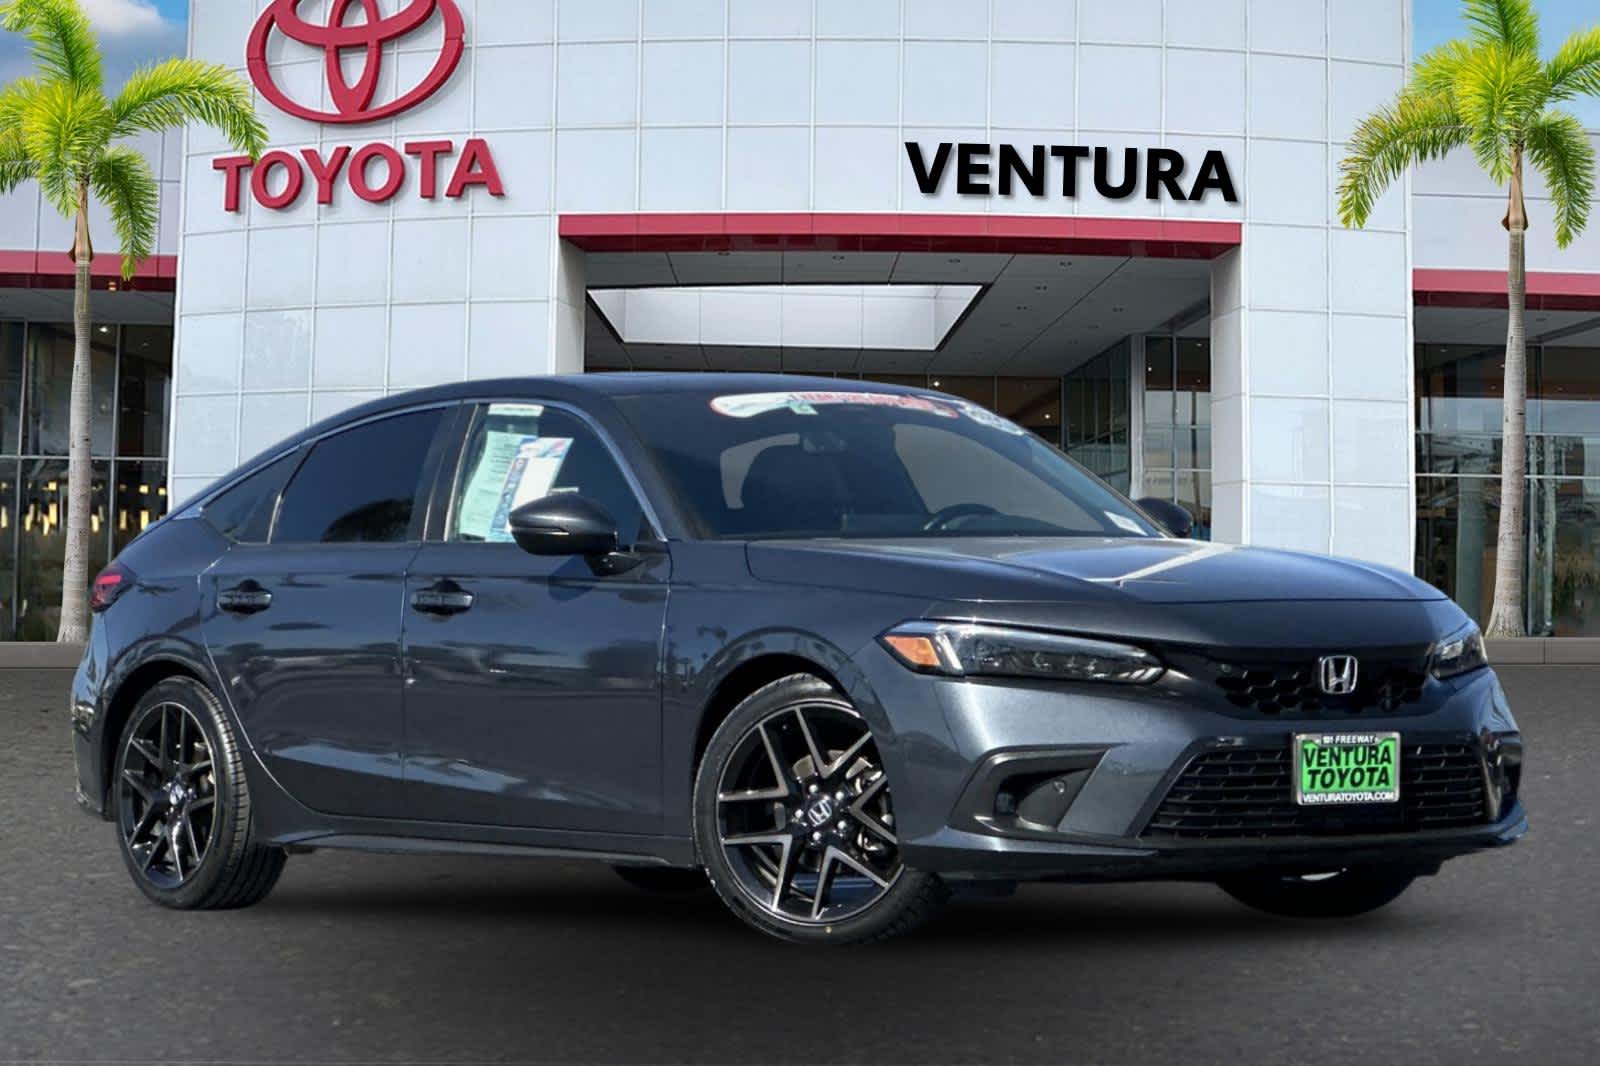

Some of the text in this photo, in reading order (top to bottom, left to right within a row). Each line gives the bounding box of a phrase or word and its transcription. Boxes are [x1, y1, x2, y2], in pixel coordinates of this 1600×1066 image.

[212, 138, 505, 212] TOYOTA
[905, 142, 1240, 203] VENTURA
[1335, 735, 1375, 745] FREEWAY
[1303, 745, 1393, 768] VENTURA
[1307, 766, 1391, 789] TOYOTA
